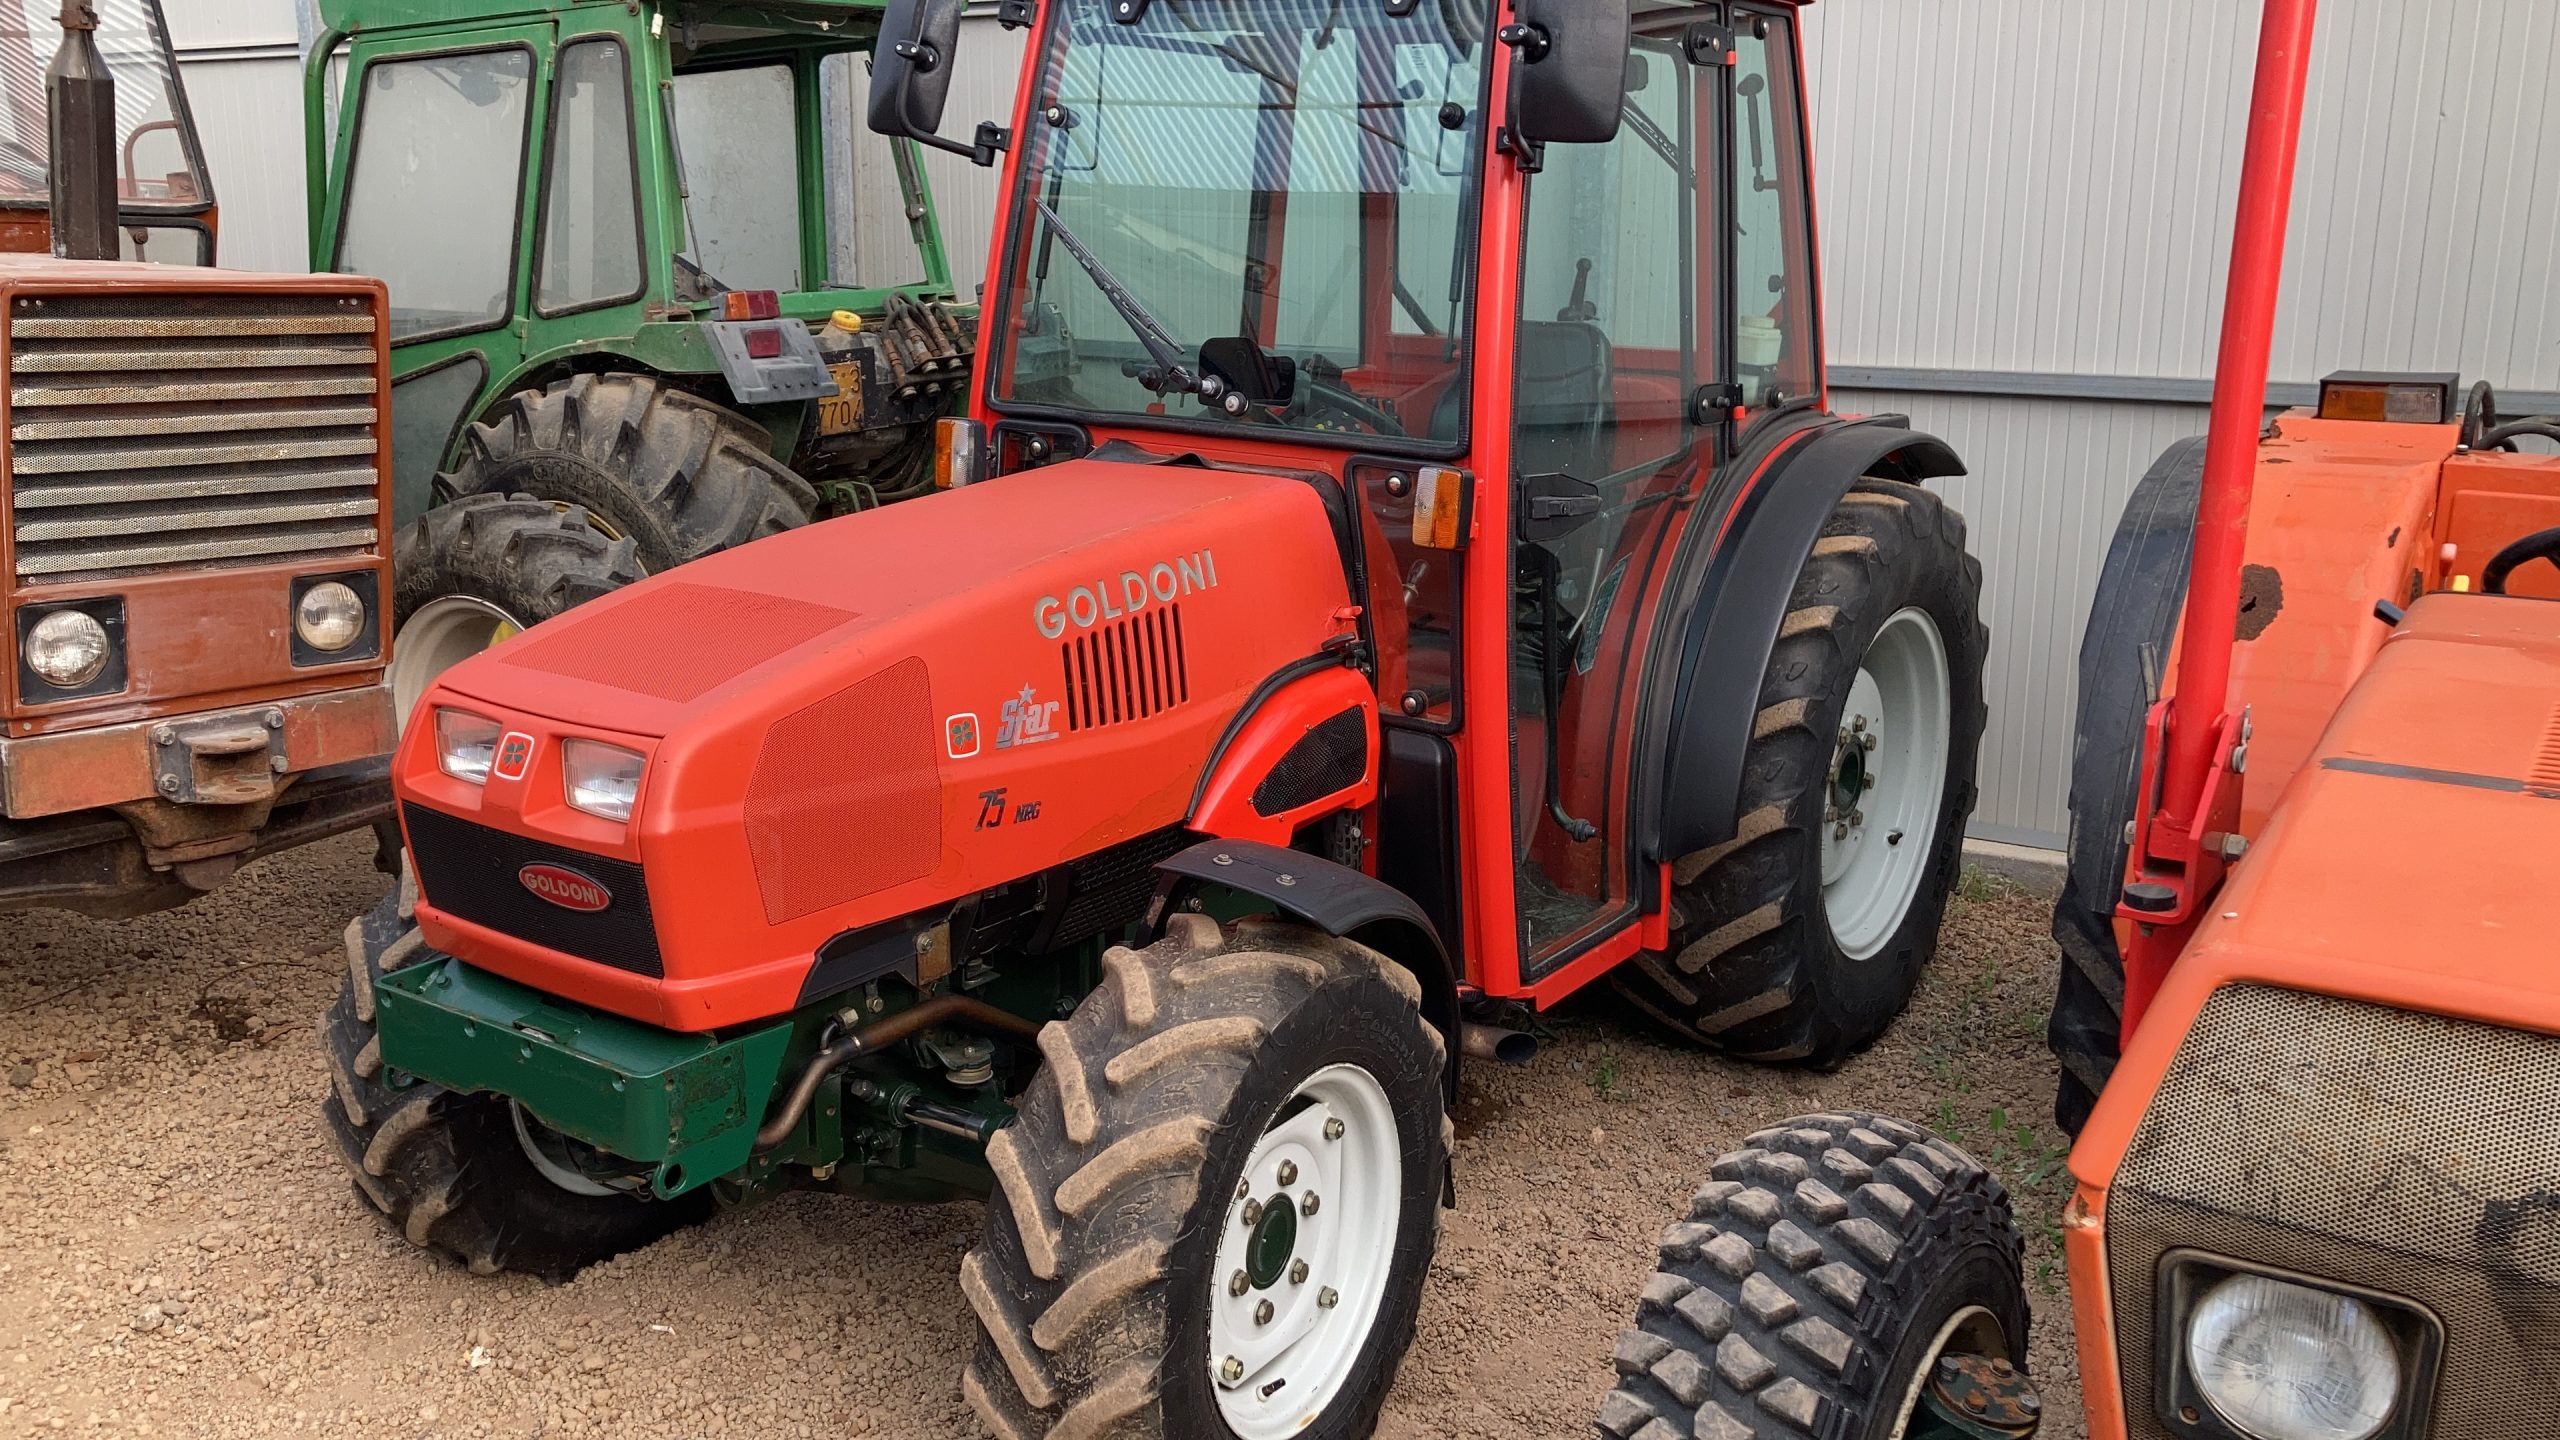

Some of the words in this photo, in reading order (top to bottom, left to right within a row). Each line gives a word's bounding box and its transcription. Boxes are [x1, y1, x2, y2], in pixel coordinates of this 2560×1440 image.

[1034, 548, 1218, 640] GOLDONI
[995, 697, 1060, 750] Star
[975, 787, 1008, 833] 75
[524, 871, 601, 906] GOLDONI
